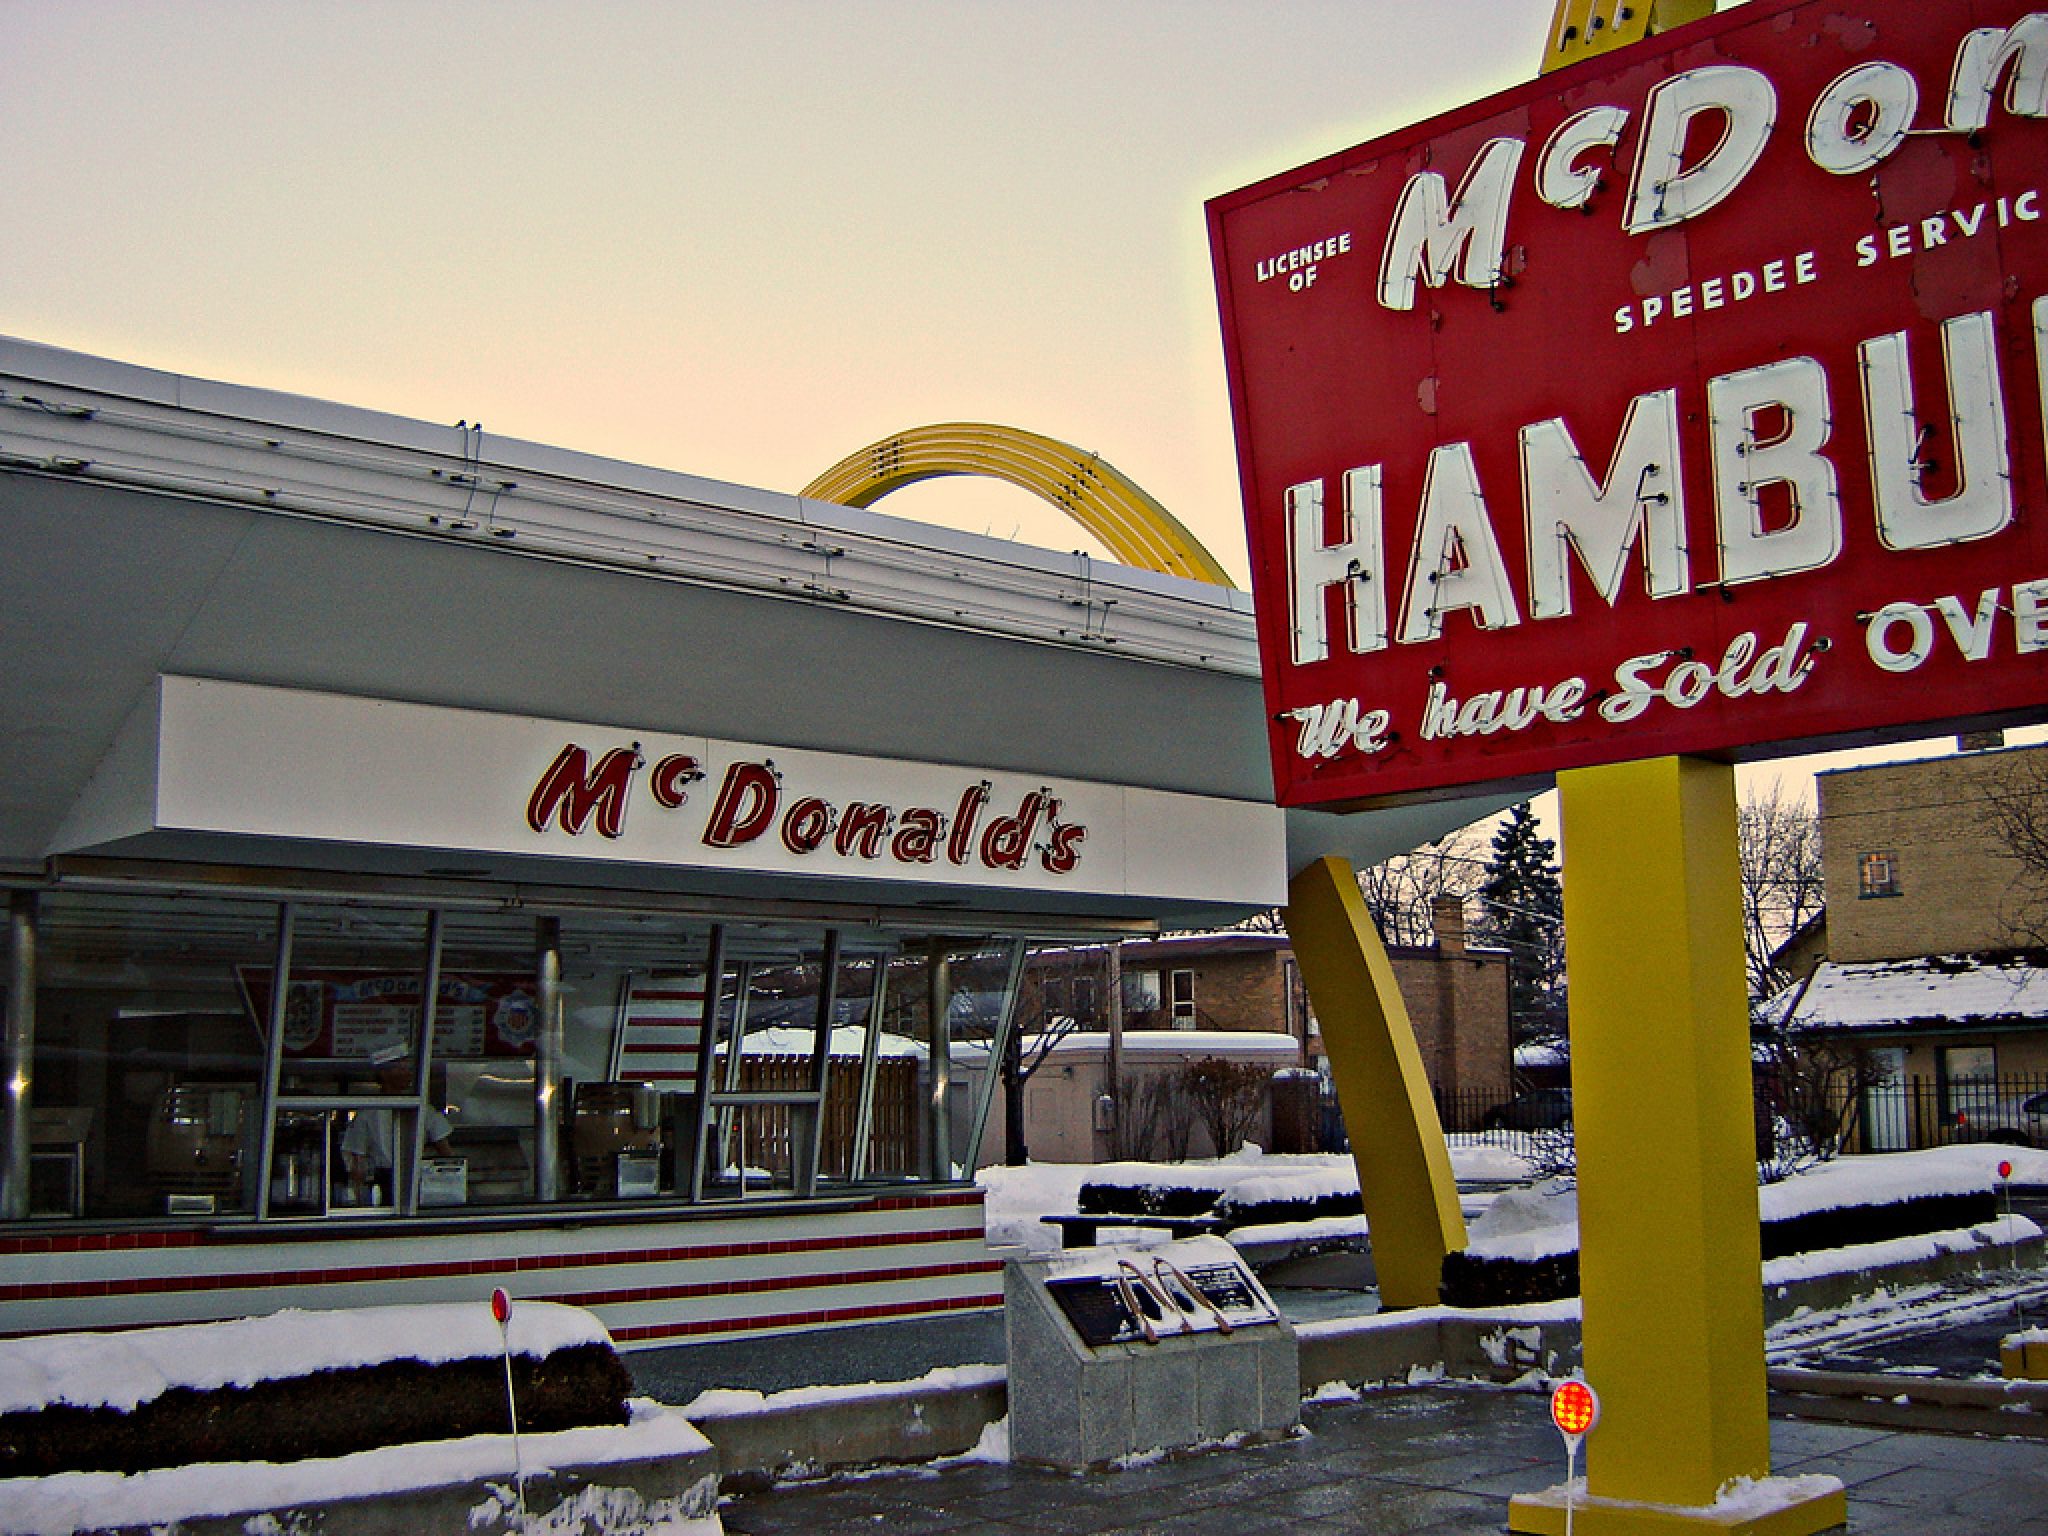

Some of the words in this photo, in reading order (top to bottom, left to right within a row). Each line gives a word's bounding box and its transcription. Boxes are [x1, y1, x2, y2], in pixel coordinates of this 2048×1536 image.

[1257, 232, 1351, 282] LICENSEE
[1289, 266, 1317, 292] OF
[1614, 250, 1818, 334] SPEEDEE
[1856, 190, 2040, 266] SERVIC
[1284, 294, 2048, 666] HAMBU
[1294, 696, 1391, 759] We
[1419, 677, 1588, 741] have
[1598, 621, 1814, 723] Sold
[1865, 578, 2048, 673] OVE
[526, 743, 1088, 874] McDonald's
